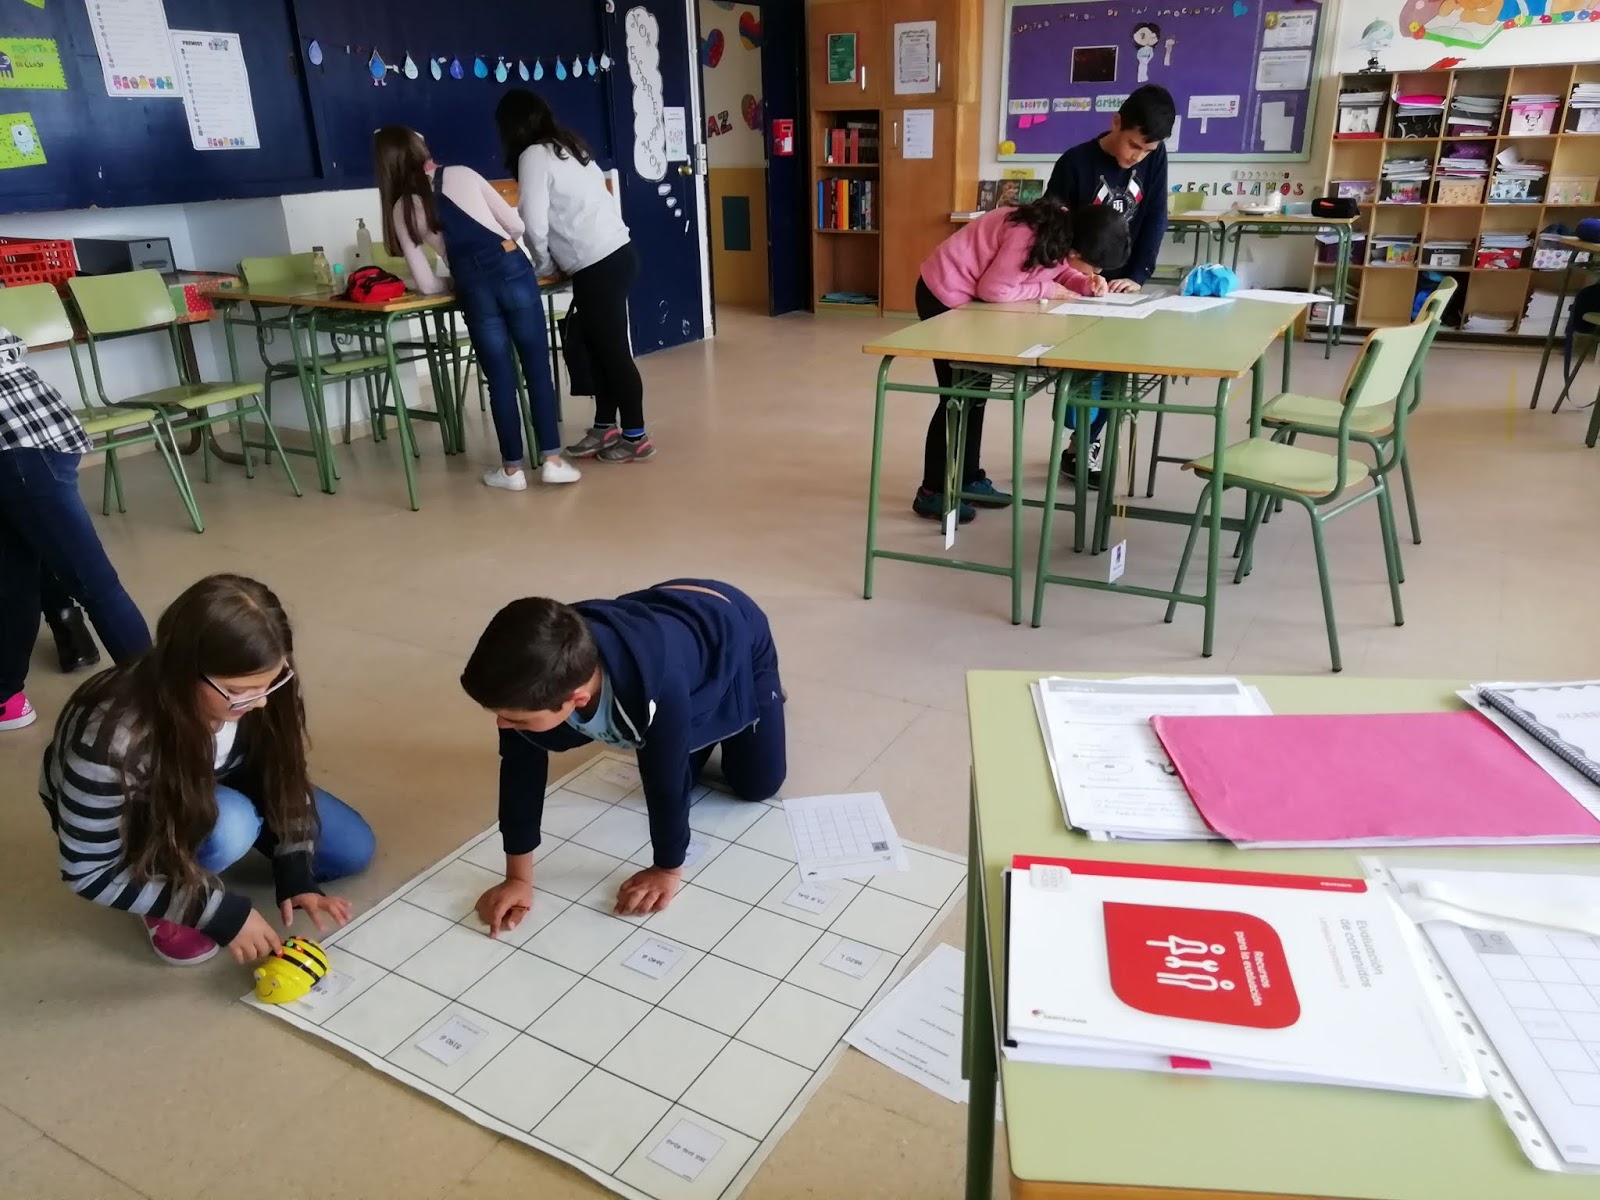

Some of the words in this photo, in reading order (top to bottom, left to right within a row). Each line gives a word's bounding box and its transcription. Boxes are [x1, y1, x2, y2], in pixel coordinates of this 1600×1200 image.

[1171, 181, 1304, 196] RECICLAMOS
[1339, 918, 1351, 930] de
[1233, 930, 1248, 950] para
[1355, 919, 1382, 975] Evaluación
[1239, 951, 1251, 960] la
[1253, 950, 1271, 989] Recursos
[1344, 932, 1372, 987] contenidos
[1242, 960, 1262, 1007] evaluación
